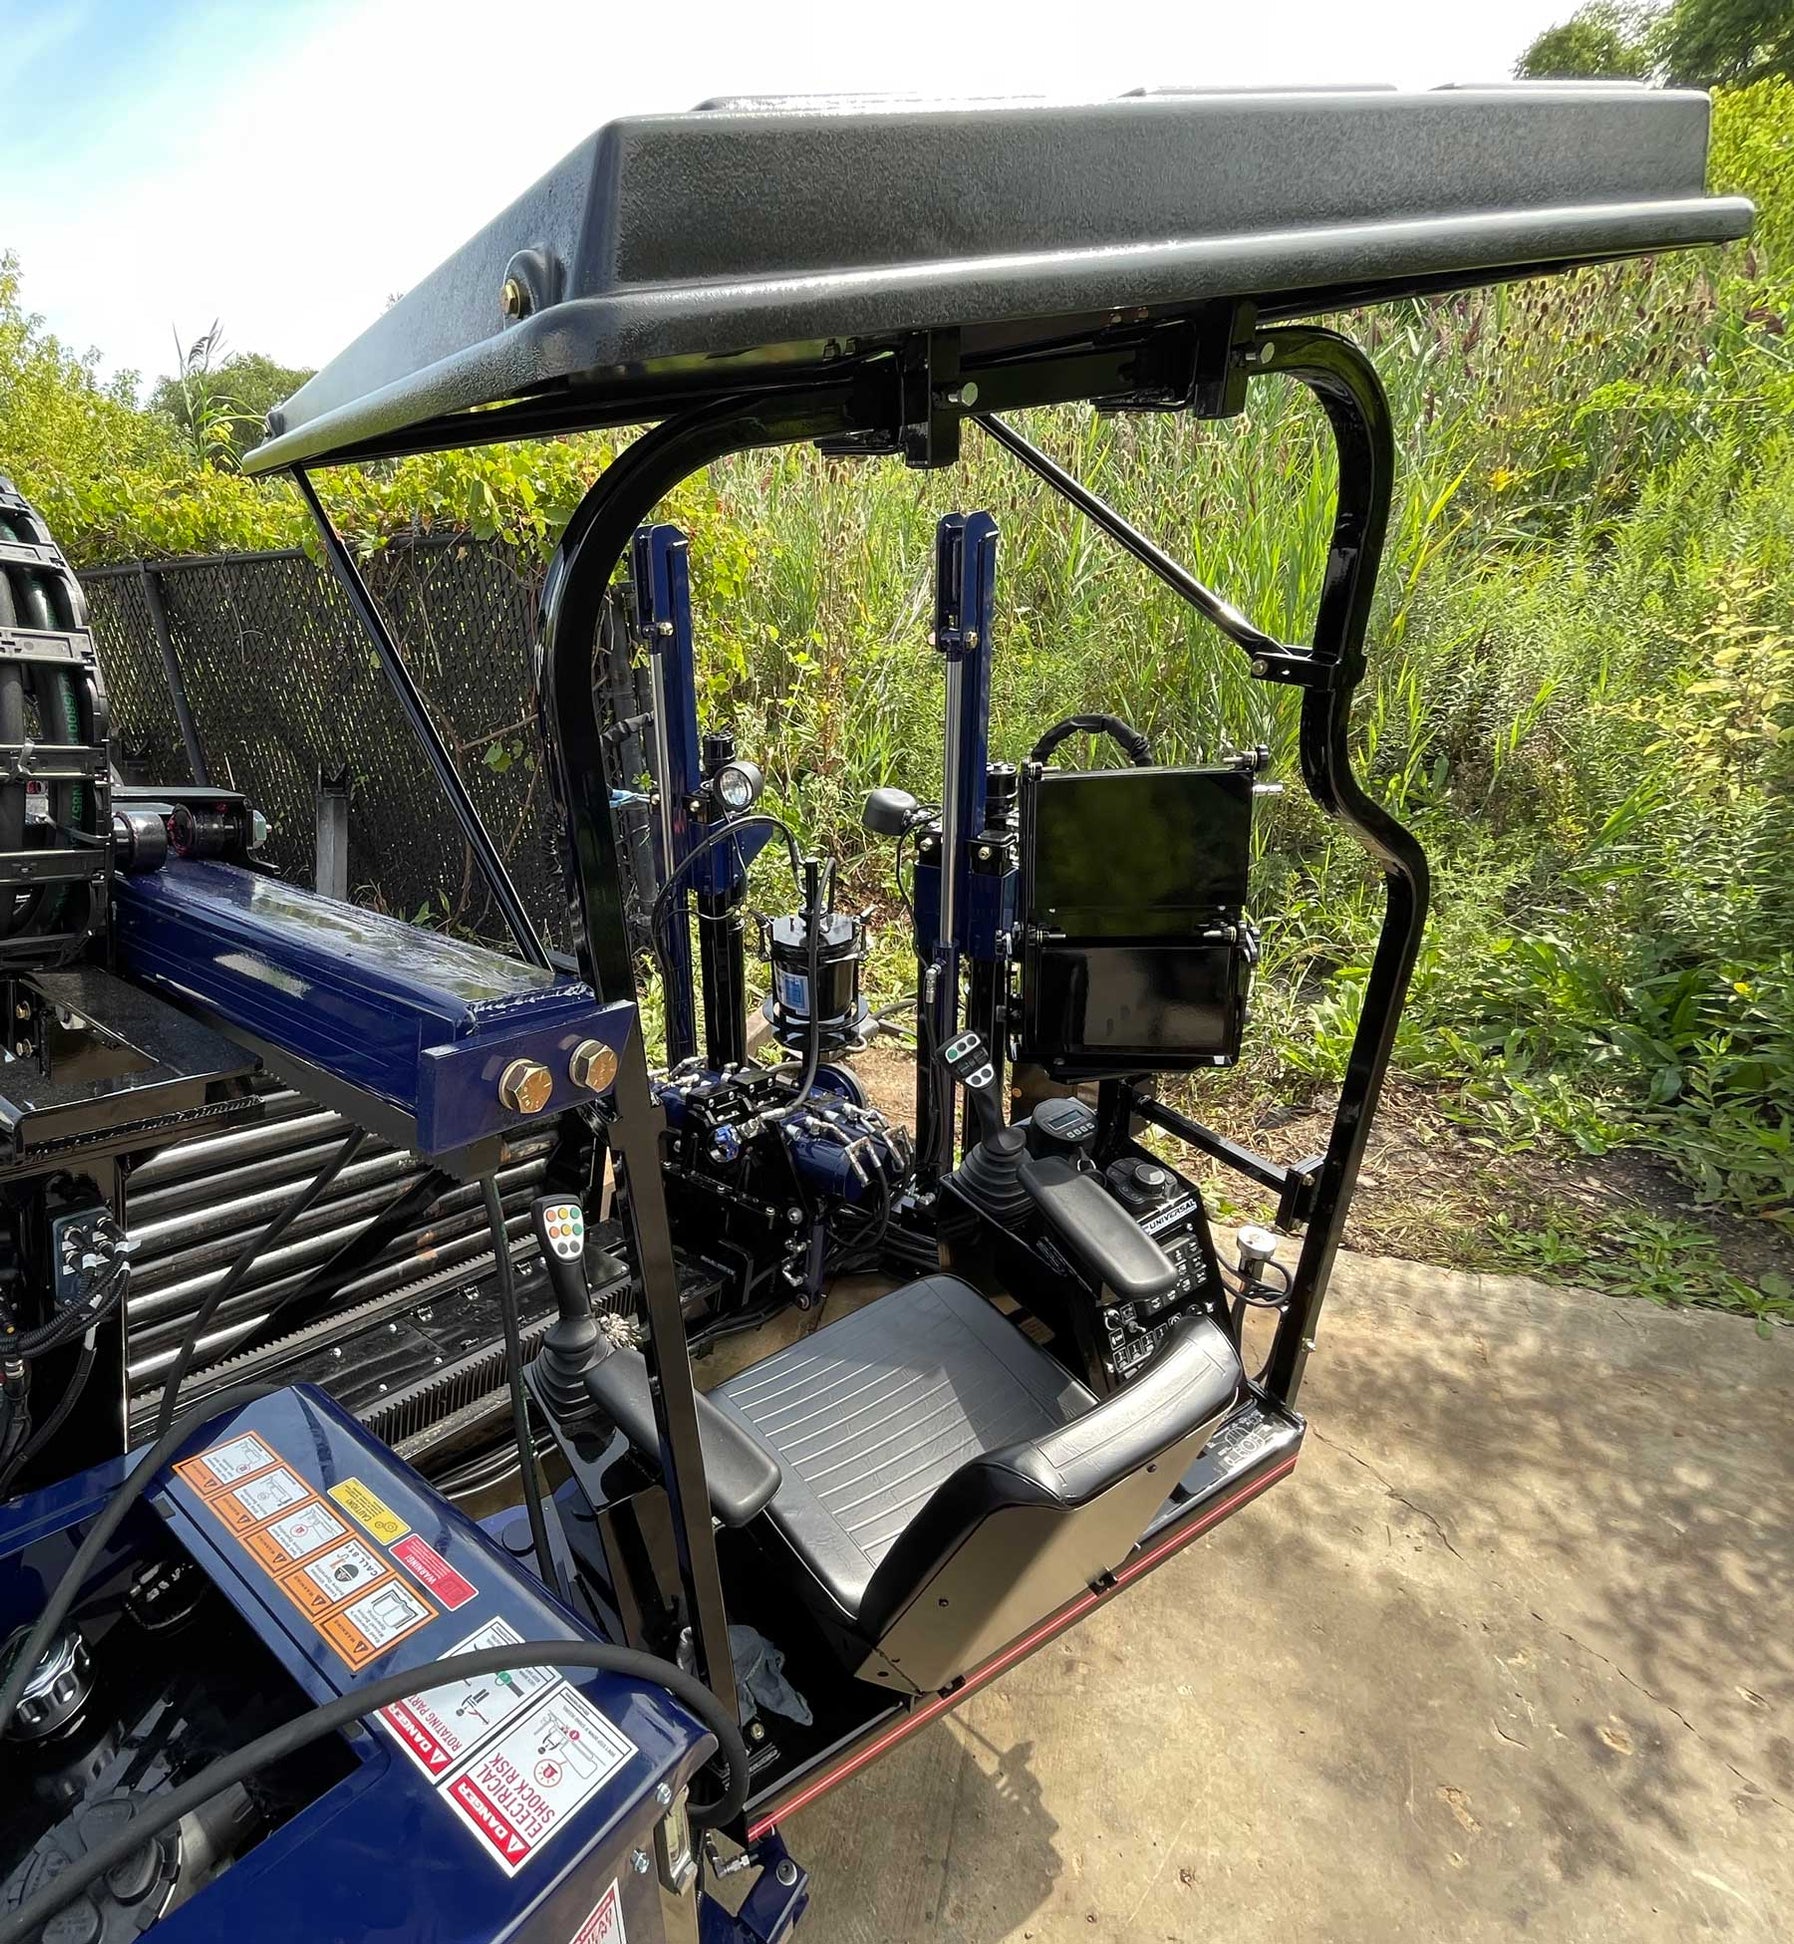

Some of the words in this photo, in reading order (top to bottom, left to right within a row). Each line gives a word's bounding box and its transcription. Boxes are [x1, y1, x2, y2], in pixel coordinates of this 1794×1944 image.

[1148, 1198, 1196, 1230] UNIVERSAL
[343, 1497, 373, 1522] CAUTION!
[343, 1543, 360, 1558] 811
[356, 1556, 379, 1577] CALL
[402, 1552, 439, 1585] WARNING!
[406, 1692, 431, 1716] PART
[384, 1701, 434, 1753] DANGER
[423, 1710, 463, 1753] ROTATING
[487, 1751, 521, 1785] RISK
[454, 1780, 510, 1841] DANGER
[472, 1762, 544, 1839] ELECTRICAL
[512, 1777, 557, 1825] SHOCK
